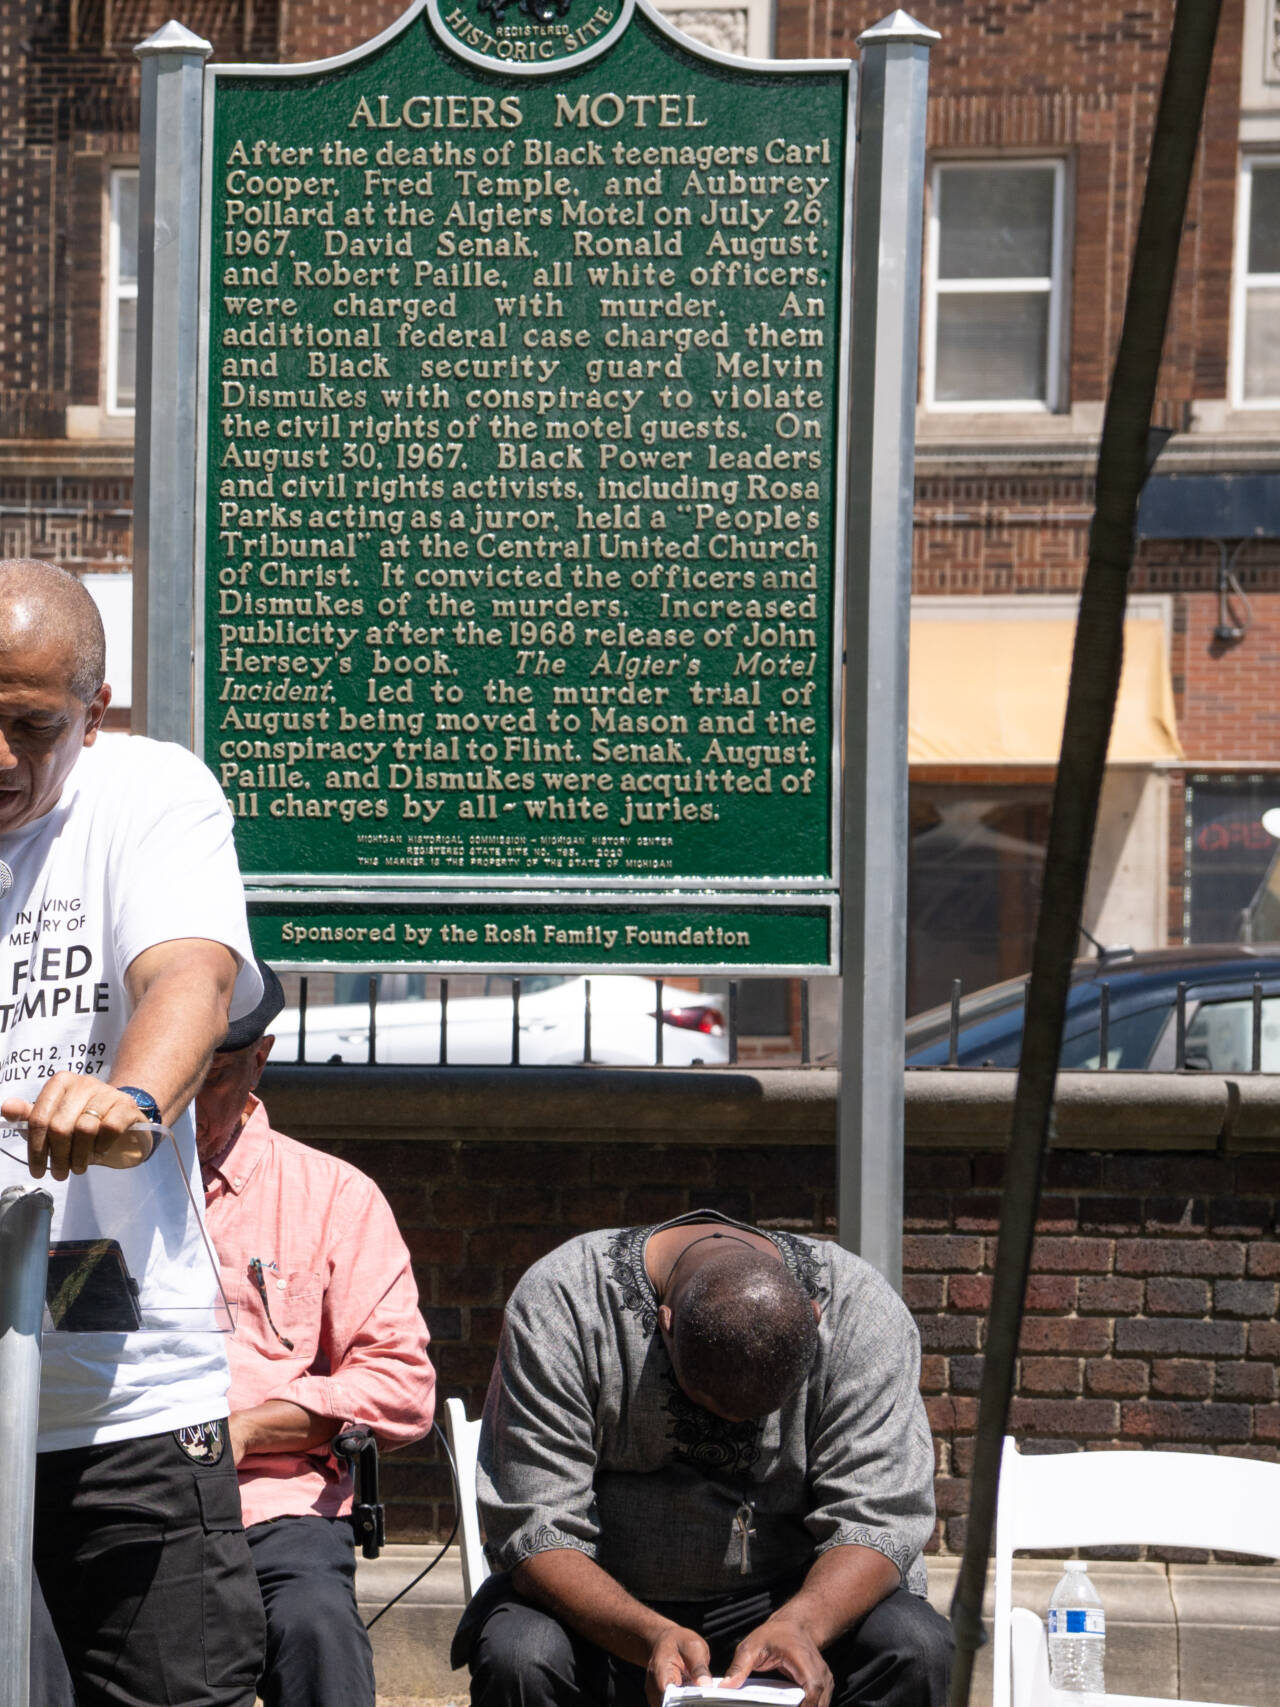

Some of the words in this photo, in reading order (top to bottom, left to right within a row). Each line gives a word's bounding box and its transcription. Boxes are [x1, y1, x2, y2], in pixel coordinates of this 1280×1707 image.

[444, 6, 555, 60] HISTORIC
[563, 5, 614, 53] SITE
[495, 24, 570, 37] REGISTERED
[349, 94, 524, 128] ALGIERS
[553, 92, 709, 128] MOTEL
[226, 140, 314, 166] After
[319, 140, 368, 166] the
[375, 140, 476, 166] deaths
[482, 139, 516, 166] of
[523, 138, 606, 166] Black
[611, 140, 759, 171] teenagers
[765, 137, 831, 164] Carl
[363, 169, 434, 196] Fred
[604, 167, 663, 196] and
[681, 169, 830, 201] Auburey
[225, 199, 335, 226] Pollard
[344, 200, 375, 226] at
[383, 199, 435, 226] the
[443, 200, 553, 233] Algiers
[561, 198, 645, 226] Motel
[654, 206, 692, 226] on
[700, 199, 774, 232] July
[223, 296, 297, 316] were
[333, 292, 457, 323] charged
[493, 291, 564, 317] with
[599, 291, 726, 318] murder.
[778, 290, 825, 317] An
[222, 321, 382, 347] additional
[396, 321, 508, 348] federal
[523, 328, 591, 348] case
[604, 321, 730, 353] charged
[744, 321, 825, 347] them
[222, 351, 279, 377] and
[308, 351, 391, 378] Black
[421, 354, 561, 383] security
[586, 352, 684, 384] guard
[715, 351, 824, 378] Melvin
[221, 381, 367, 408] Dismukes
[380, 383, 450, 409] with
[465, 385, 645, 415] conspiracy
[658, 384, 694, 409] to
[711, 383, 824, 409] violate
[221, 413, 271, 438] the
[276, 413, 341, 438] civil
[348, 412, 440, 445] rights
[447, 413, 481, 439] of
[488, 414, 538, 439] the
[545, 413, 633, 439] motel
[640, 415, 748, 445] guests.
[775, 411, 823, 439] On
[219, 472, 275, 498] and
[281, 472, 347, 498] civil
[354, 473, 445, 504] rights
[598, 474, 740, 505] including
[746, 474, 820, 500] Rosa
[379, 533, 411, 558] at
[418, 532, 469, 558] the
[476, 533, 591, 559] Central
[599, 532, 700, 559] United
[708, 533, 818, 559] Church
[219, 561, 253, 586] of
[259, 561, 359, 587] Christ.
[381, 562, 406, 587] It
[414, 562, 563, 588] convicted
[570, 563, 621, 588] the
[631, 563, 756, 589] officers
[762, 563, 818, 589] and
[218, 589, 364, 616] Dismukes
[378, 591, 412, 616] of
[426, 592, 476, 617] the
[491, 591, 629, 618] murders.
[660, 592, 817, 618] Increased
[219, 619, 359, 650] publicity
[365, 620, 445, 645] after
[452, 620, 503, 645] the
[509, 620, 576, 646] 1968
[584, 621, 695, 647] release
[703, 623, 737, 647] of
[743, 621, 817, 647] John
[367, 677, 414, 703] led
[430, 680, 464, 703] to
[483, 679, 533, 704] the
[553, 681, 669, 705] murder
[689, 681, 761, 705] trial
[781, 681, 817, 705] of
[219, 705, 330, 735] August
[339, 706, 425, 736] being
[435, 707, 537, 732] moved
[546, 709, 581, 732] to
[590, 706, 689, 733] Mason
[698, 709, 755, 734] and
[765, 711, 816, 734] the
[269, 792, 389, 822] charges
[402, 793, 445, 823] by
[16, 912, 32, 925] IN
[67, 915, 86, 931] OF
[280, 922, 396, 944] Sponsored
[404, 923, 433, 946] by
[440, 924, 478, 943] the
[484, 924, 537, 944] Rosh
[543, 925, 618, 950] Family
[624, 926, 751, 947] Foundation
[12, 944, 93, 995] FED
[49, 1046, 61, 1061] 2,
[70, 1042, 106, 1058] 1949
[67, 1060, 104, 1075] 1967
